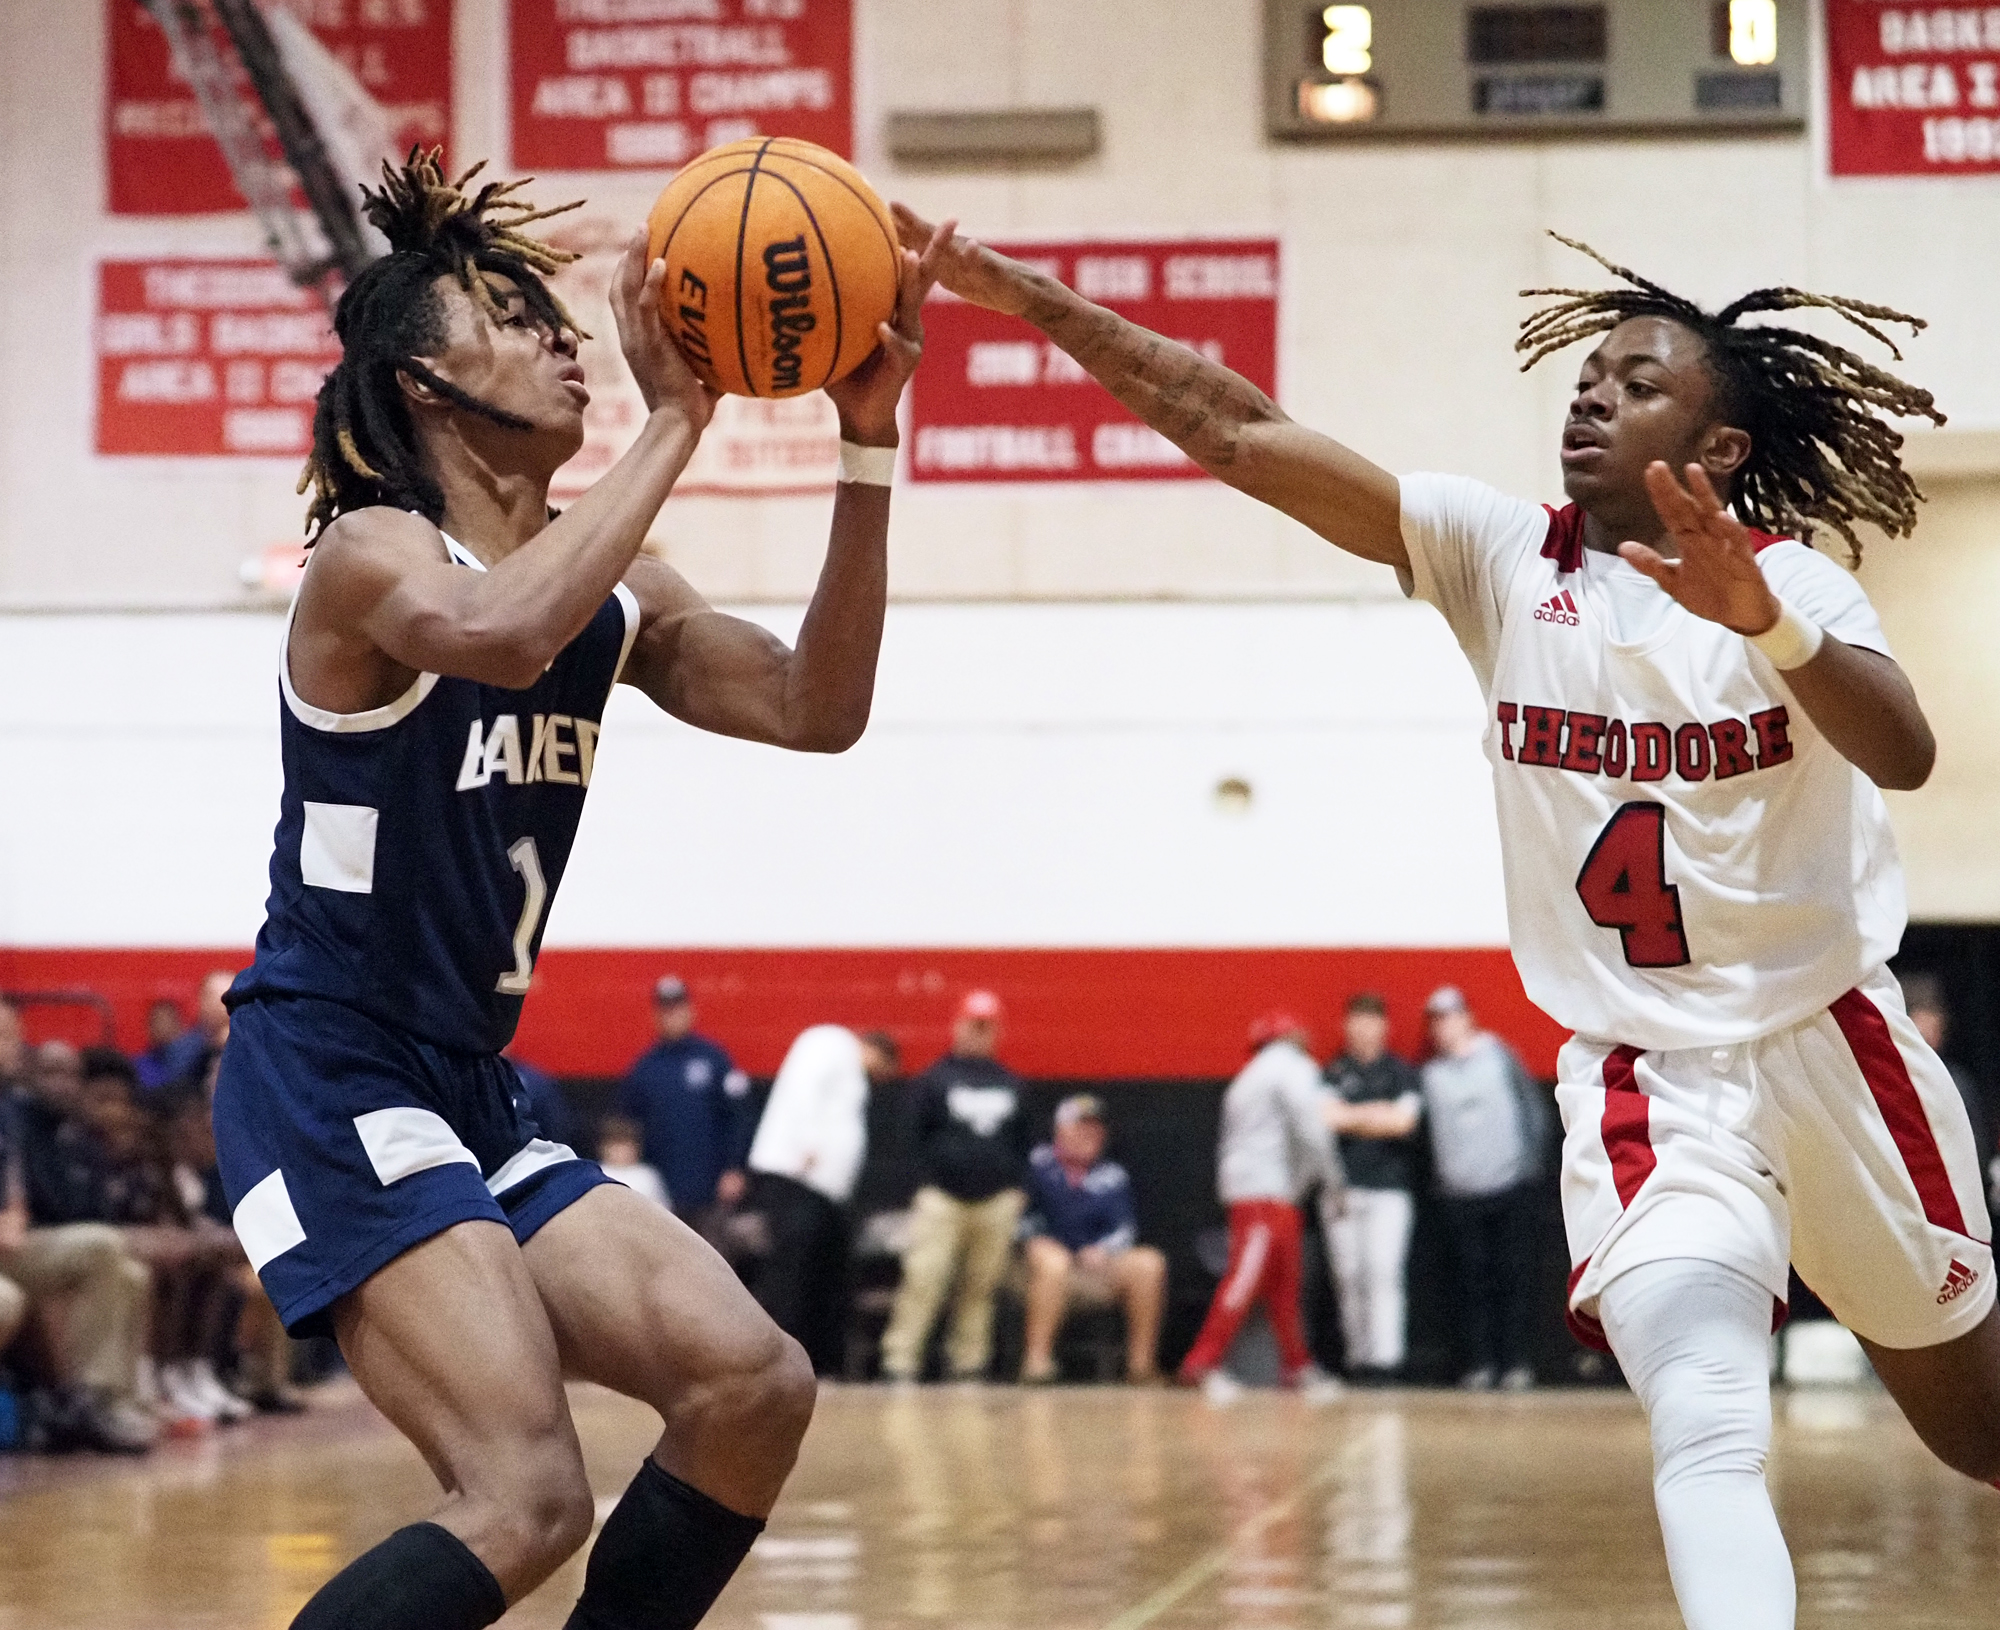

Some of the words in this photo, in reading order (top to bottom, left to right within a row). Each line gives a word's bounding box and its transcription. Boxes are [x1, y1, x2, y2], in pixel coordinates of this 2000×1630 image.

[1323, 5, 1372, 74] 2
[1729, 0, 1777, 65] 0
[762, 233, 816, 392] Wilson
[1534, 609, 1580, 626] adidas
[1497, 700, 1794, 782] THEODORE
[494, 836, 548, 996] 1
[1575, 800, 1691, 969] 4
[1936, 1269, 1979, 1305] adidas
